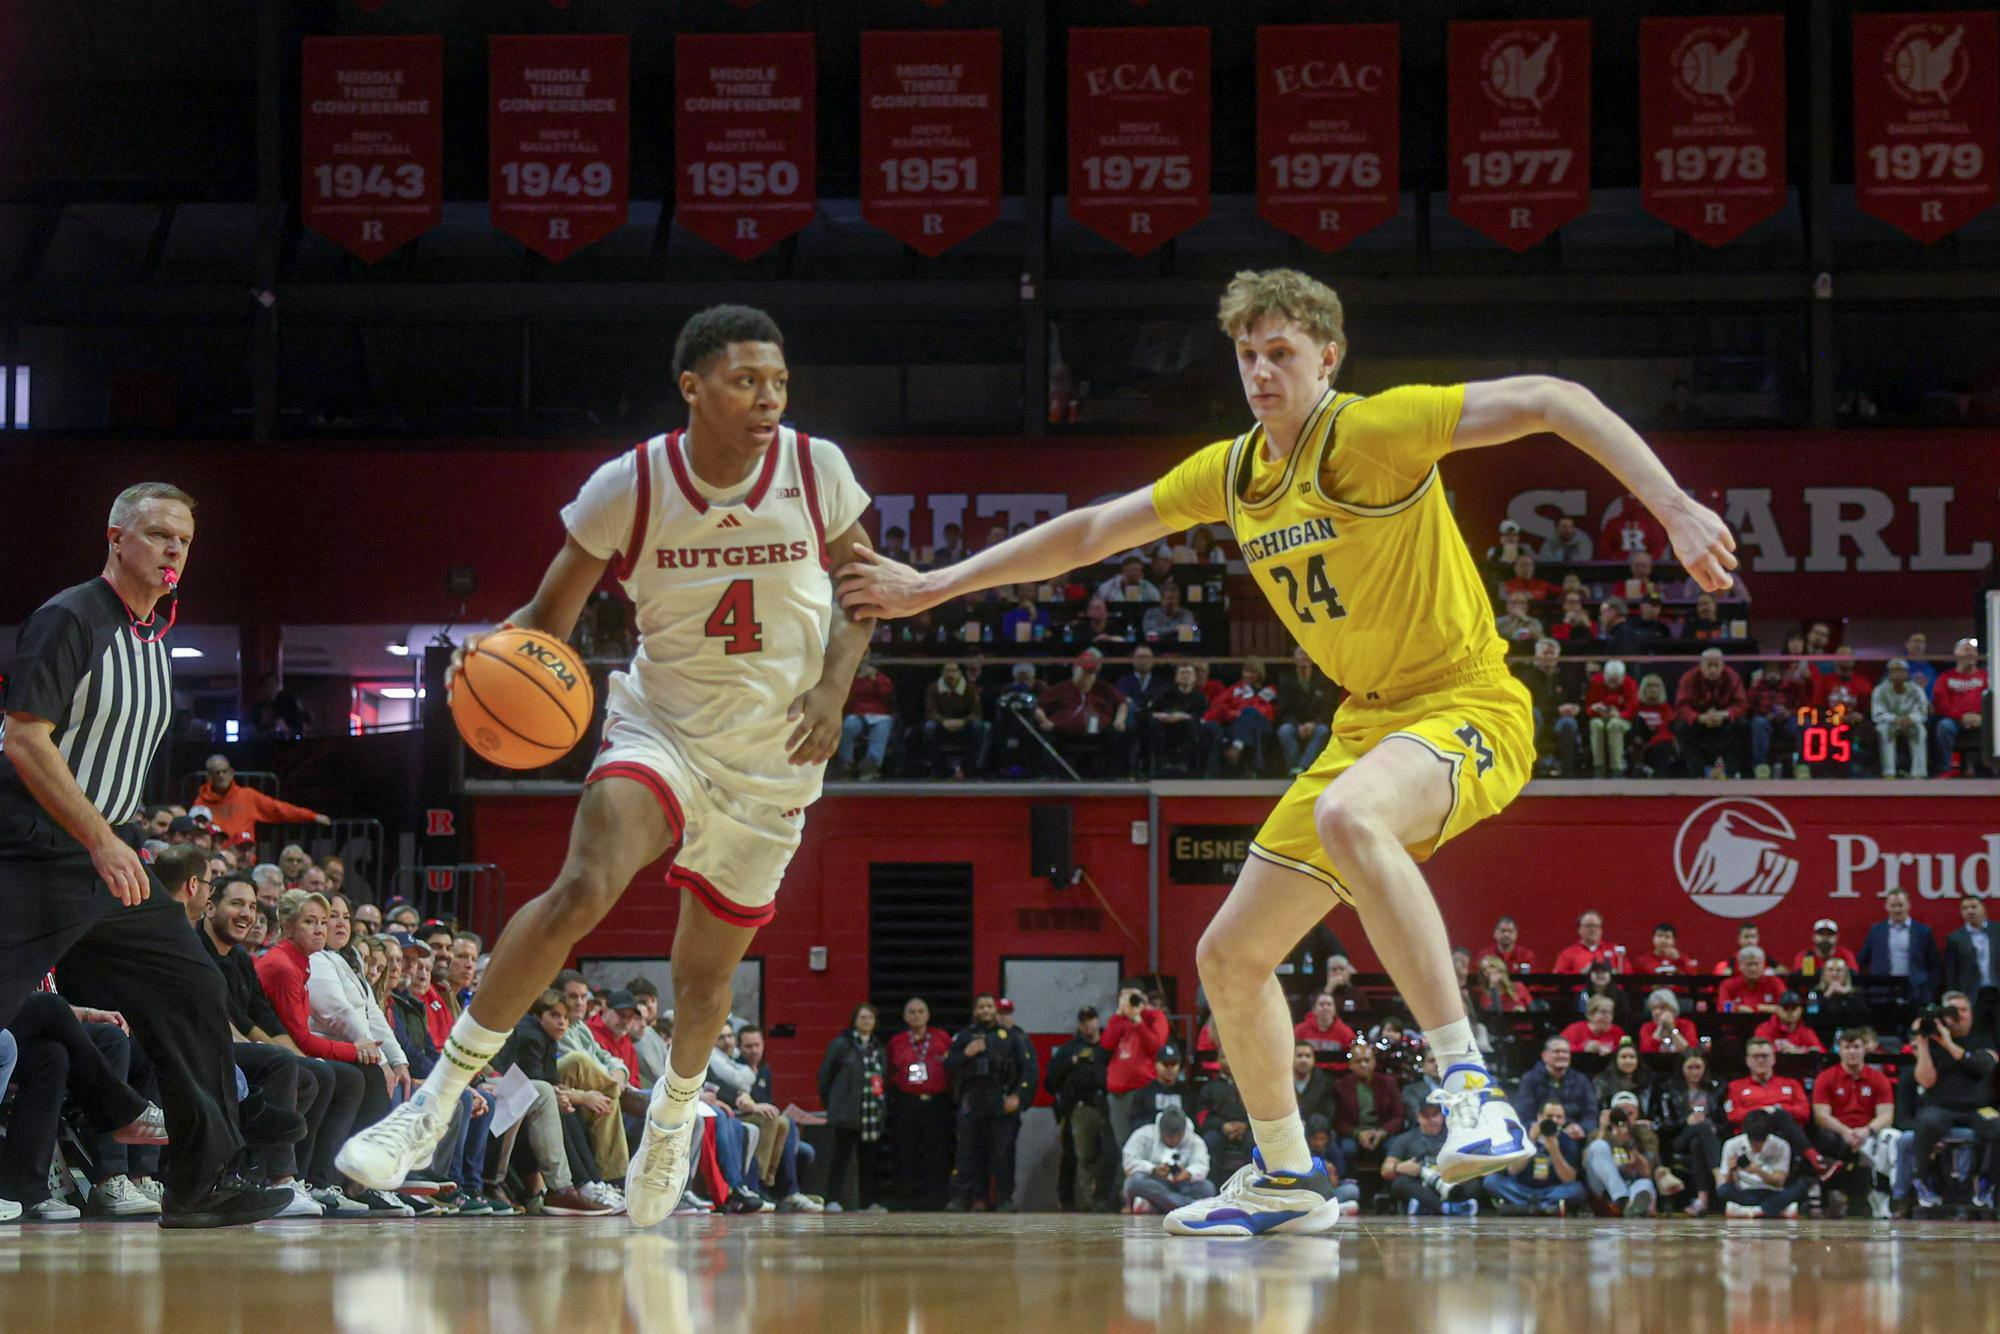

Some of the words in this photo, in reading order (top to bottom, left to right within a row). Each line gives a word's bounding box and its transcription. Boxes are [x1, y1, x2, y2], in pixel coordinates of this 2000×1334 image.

[896, 64, 963, 79] MIDDLE
[1085, 63, 1195, 97] ECAC
[1272, 60, 1383, 95] ECAC
[311, 100, 430, 114] CONFERENCE
[499, 99, 617, 113] CONFERENCE
[685, 97, 802, 112] CONFERENCE
[870, 94, 988, 109] CONFERENCE
[879, 158, 978, 193] 1951
[1082, 155, 1192, 191] 1975
[1270, 153, 1382, 188] 1976
[1462, 148, 1573, 187] 1977
[1654, 145, 1767, 182] 1978
[1868, 143, 1984, 181] 1979
[314, 163, 425, 198] 1943
[501, 162, 613, 197] 1949
[687, 160, 799, 197] 1950
[923, 214, 944, 235] R
[1130, 212, 1152, 233] R
[1319, 209, 1341, 231] R
[1510, 207, 1531, 229] R
[1704, 203, 1727, 225] R
[1920, 200, 1944, 223] R
[362, 220, 384, 241] R
[548, 219, 571, 240] R
[736, 218, 758, 239] R
[1620, 528, 1648, 552] R
[657, 541, 808, 570] RUTGERS
[1269, 554, 1348, 624] 24
[705, 579, 764, 656] 4
[517, 640, 577, 691] NCAA
[1803, 723, 1851, 763] 05
[426, 808, 455, 836] R
[1176, 836, 1247, 861] EISNE
[1827, 833, 2000, 899] Prud
